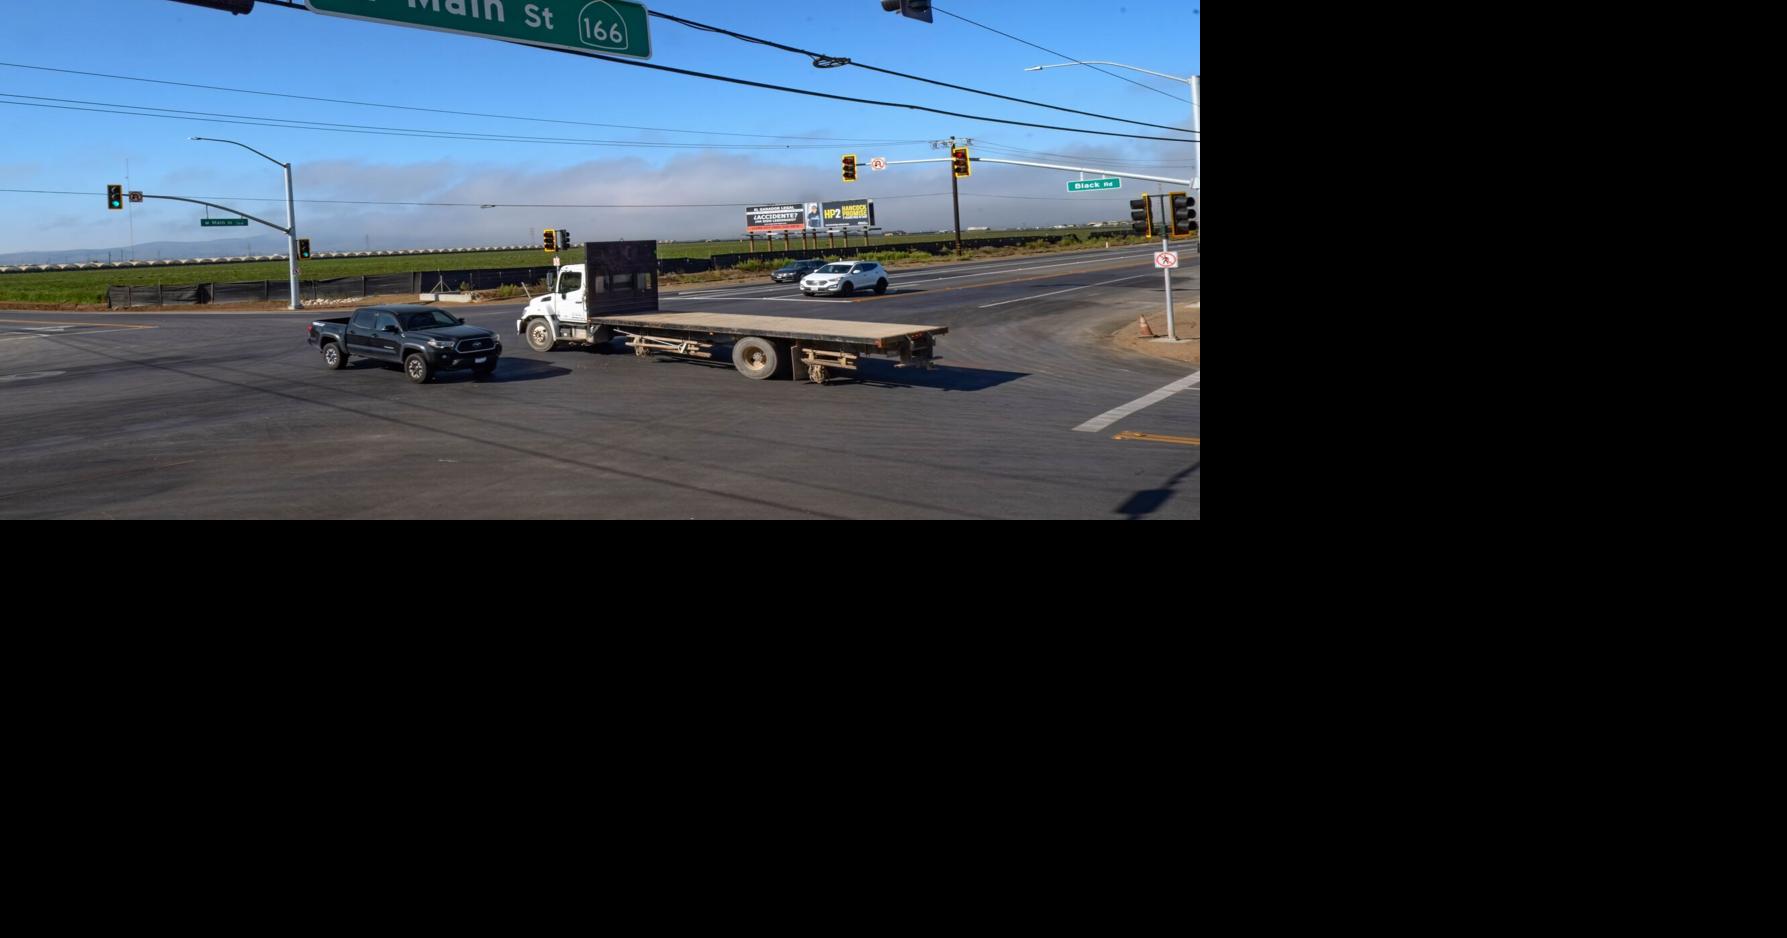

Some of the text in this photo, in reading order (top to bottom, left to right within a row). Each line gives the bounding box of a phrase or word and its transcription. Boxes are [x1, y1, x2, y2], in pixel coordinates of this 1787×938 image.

[524, 3, 554, 30] St
[583, 17, 623, 43] 166
[824, 209, 841, 219] HP2
